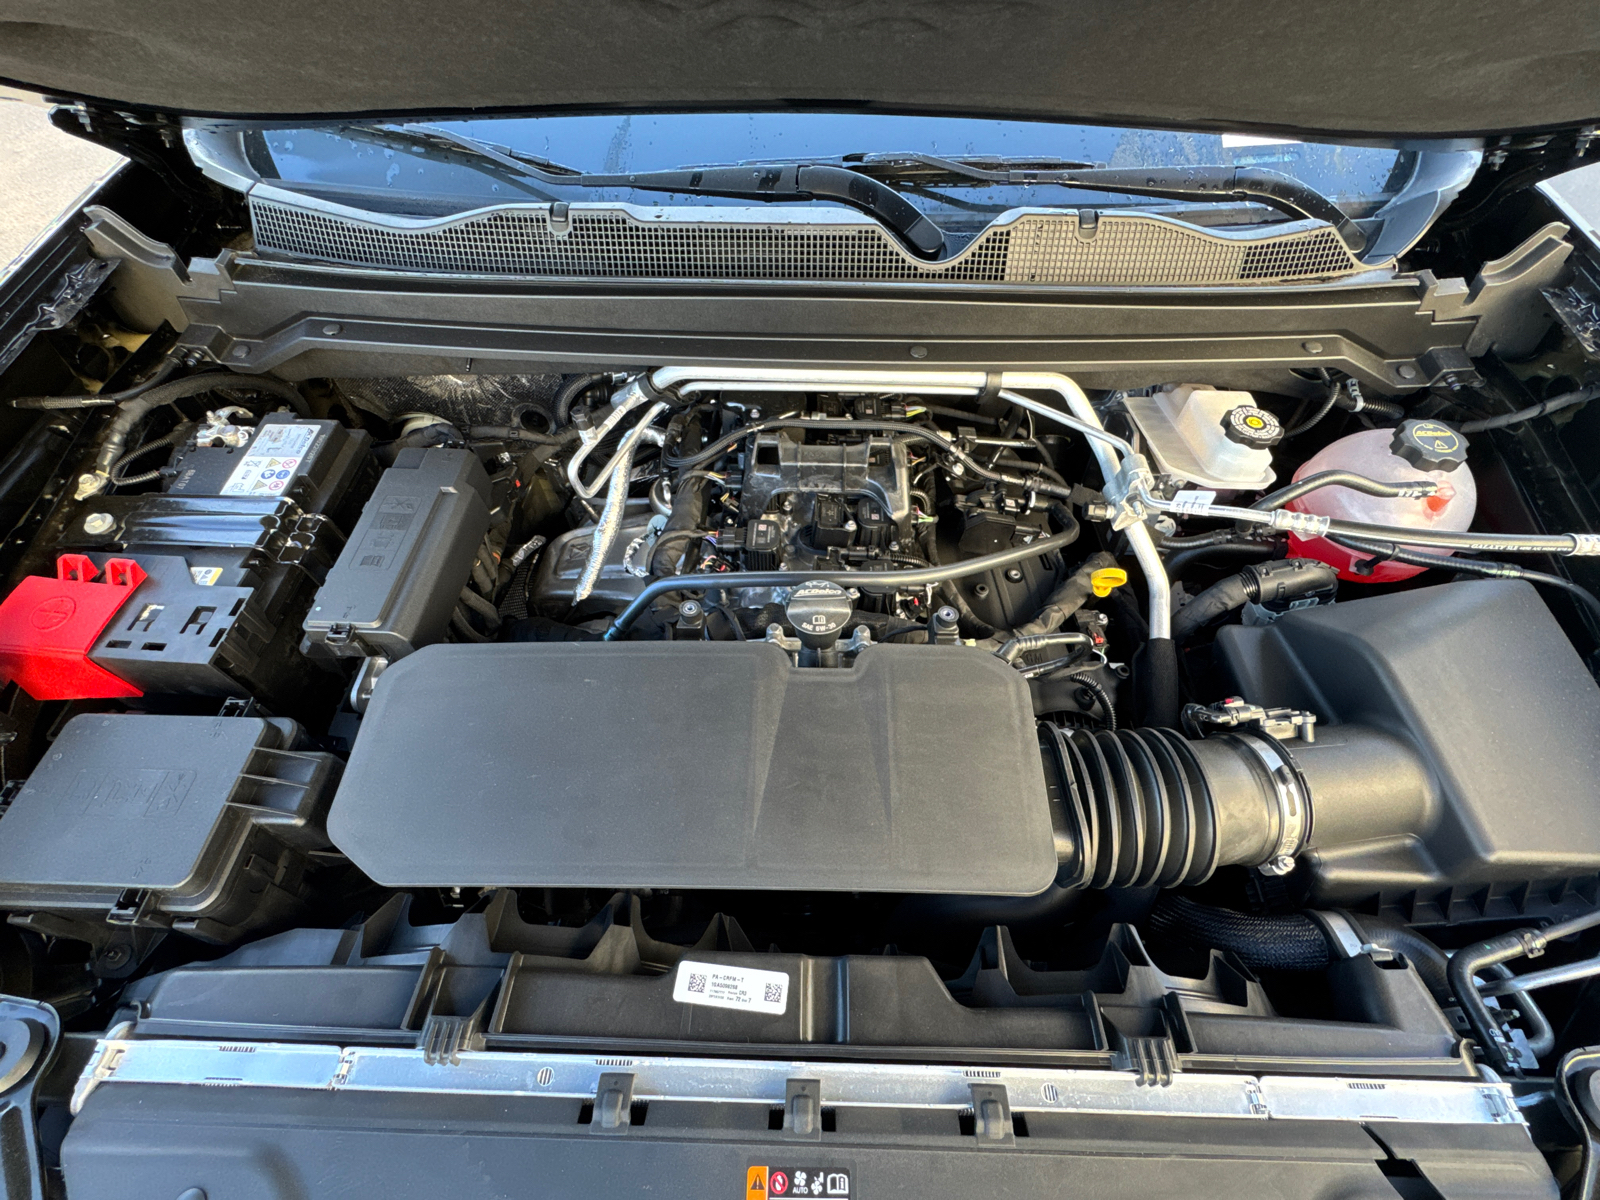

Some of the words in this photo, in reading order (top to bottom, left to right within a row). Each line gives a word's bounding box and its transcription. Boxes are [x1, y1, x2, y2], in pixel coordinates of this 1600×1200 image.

[794, 589, 841, 597] ACDelco
[802, 622, 813, 631] SAE
[816, 622, 836, 631] 5W-30
